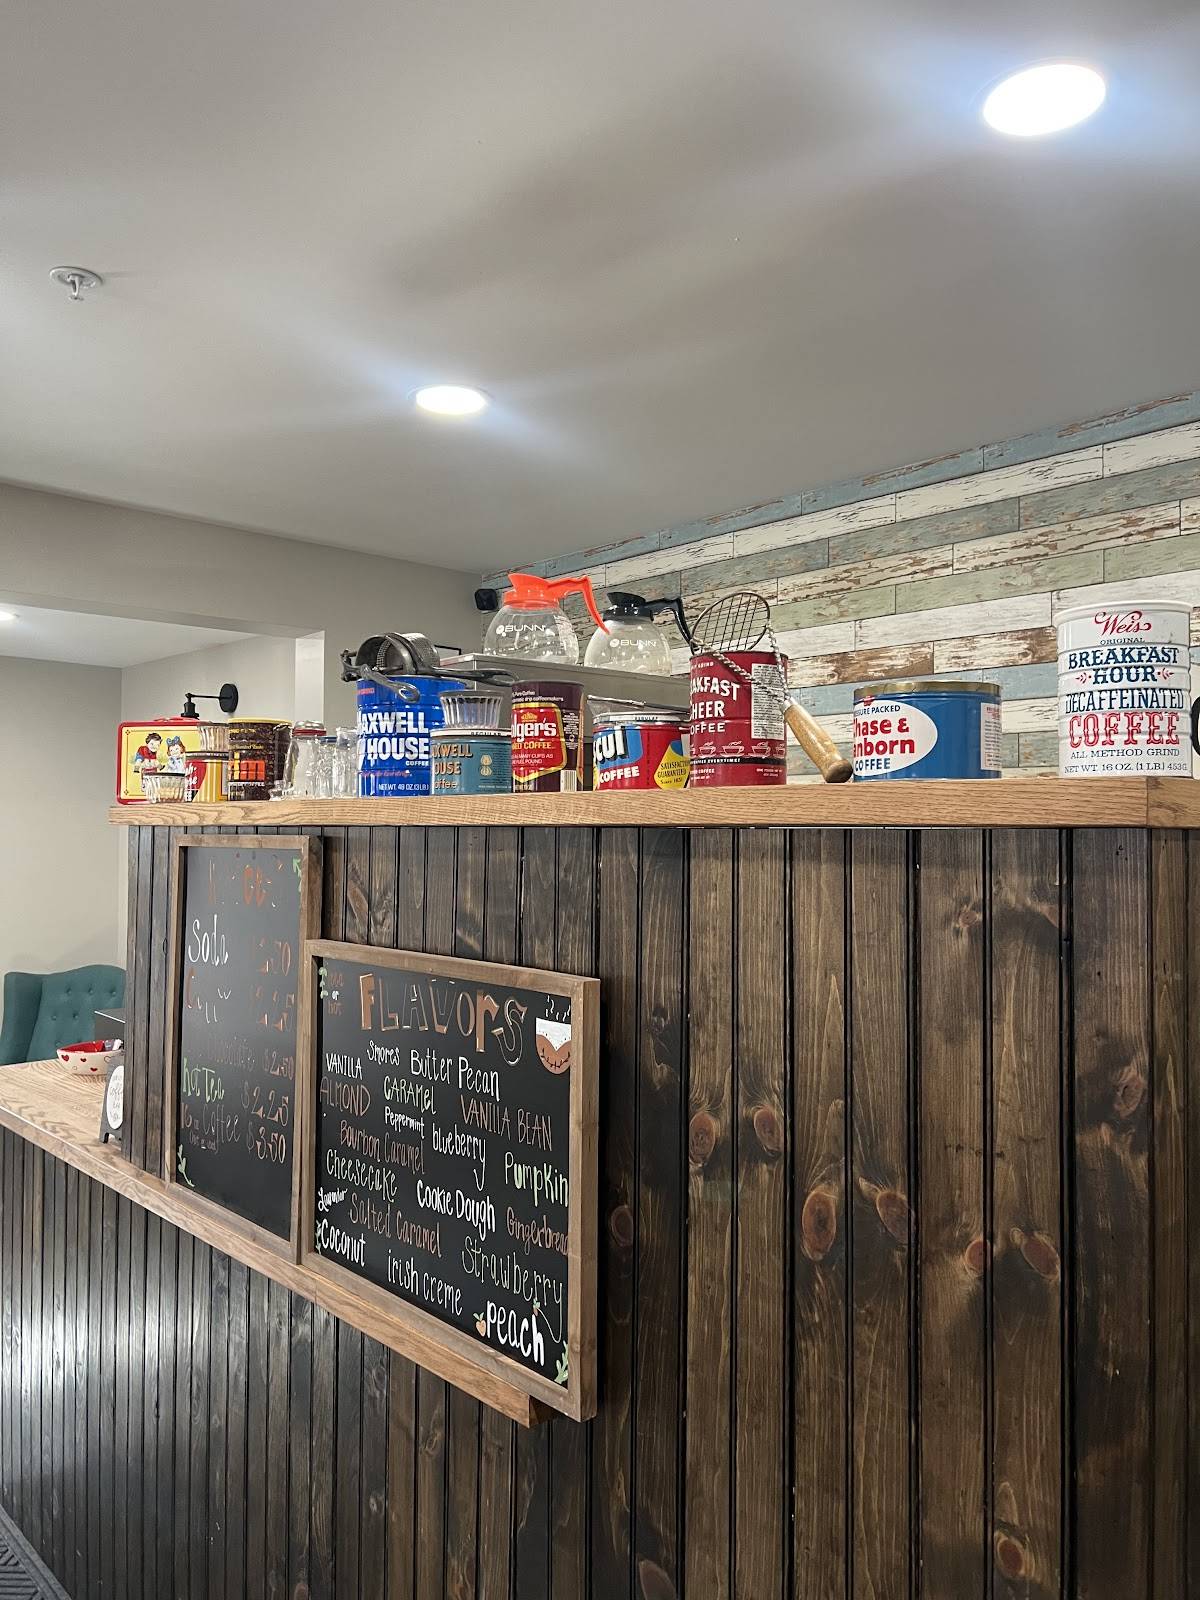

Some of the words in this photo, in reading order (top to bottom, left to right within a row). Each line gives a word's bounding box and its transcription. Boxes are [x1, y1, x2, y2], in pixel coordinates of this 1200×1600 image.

[504, 624, 546, 632] BUNN
[1094, 610, 1152, 636] Weis
[620, 638, 656, 647] BUNN
[1068, 647, 1179, 670] BREAKFAST
[1100, 637, 1145, 645] ORIGINAL
[1092, 665, 1158, 685] HOUR
[690, 700, 725, 720] HEER
[871, 705, 900, 715] PACKED
[1065, 688, 1184, 714] DECAFFEINATED
[854, 718, 892, 737] hase
[897, 717, 910, 733] &
[1069, 712, 1180, 748] COFFEE
[367, 736, 429, 762] HOUSE
[523, 741, 552, 750] COFFEE
[1071, 751, 1087, 760] ALL
[1090, 749, 1143, 757] METHOD
[1146, 748, 1180, 757] GRIND
[599, 765, 640, 784] COFFEE
[855, 757, 891, 773] COFFEE
[1064, 766, 1080, 774] NET
[1102, 763, 1113, 771] 16
[188, 913, 229, 967] Soda
[325, 1053, 363, 1081] VANILLA
[367, 1039, 400, 1067] Smores
[202, 1066, 225, 1103] Tea
[410, 1047, 453, 1085] Butter
[458, 1056, 500, 1102] Pecan
[241, 1080, 290, 1128] $2.25
[319, 1076, 371, 1117] ALMOND
[202, 1103, 242, 1150] Coffee
[384, 1105, 426, 1140] Peppermint
[460, 1093, 511, 1141] VANILLA
[517, 1107, 553, 1152] BEAN
[246, 1121, 286, 1164] $3.50
[340, 1119, 381, 1162] Bourbon
[384, 1132, 425, 1175] Caramel
[432, 1122, 486, 1192] blueberry
[326, 1148, 398, 1203] Cheesecake
[348, 1192, 392, 1239] Salted
[396, 1209, 442, 1259] Caramel
[416, 1179, 454, 1217] Cookie
[455, 1189, 496, 1242] Dough
[321, 1218, 366, 1268] Coconut
[387, 1248, 419, 1296] irish
[423, 1272, 463, 1317] creme
[461, 1235, 563, 1344] Strawberry
[486, 1300, 545, 1367] peach
